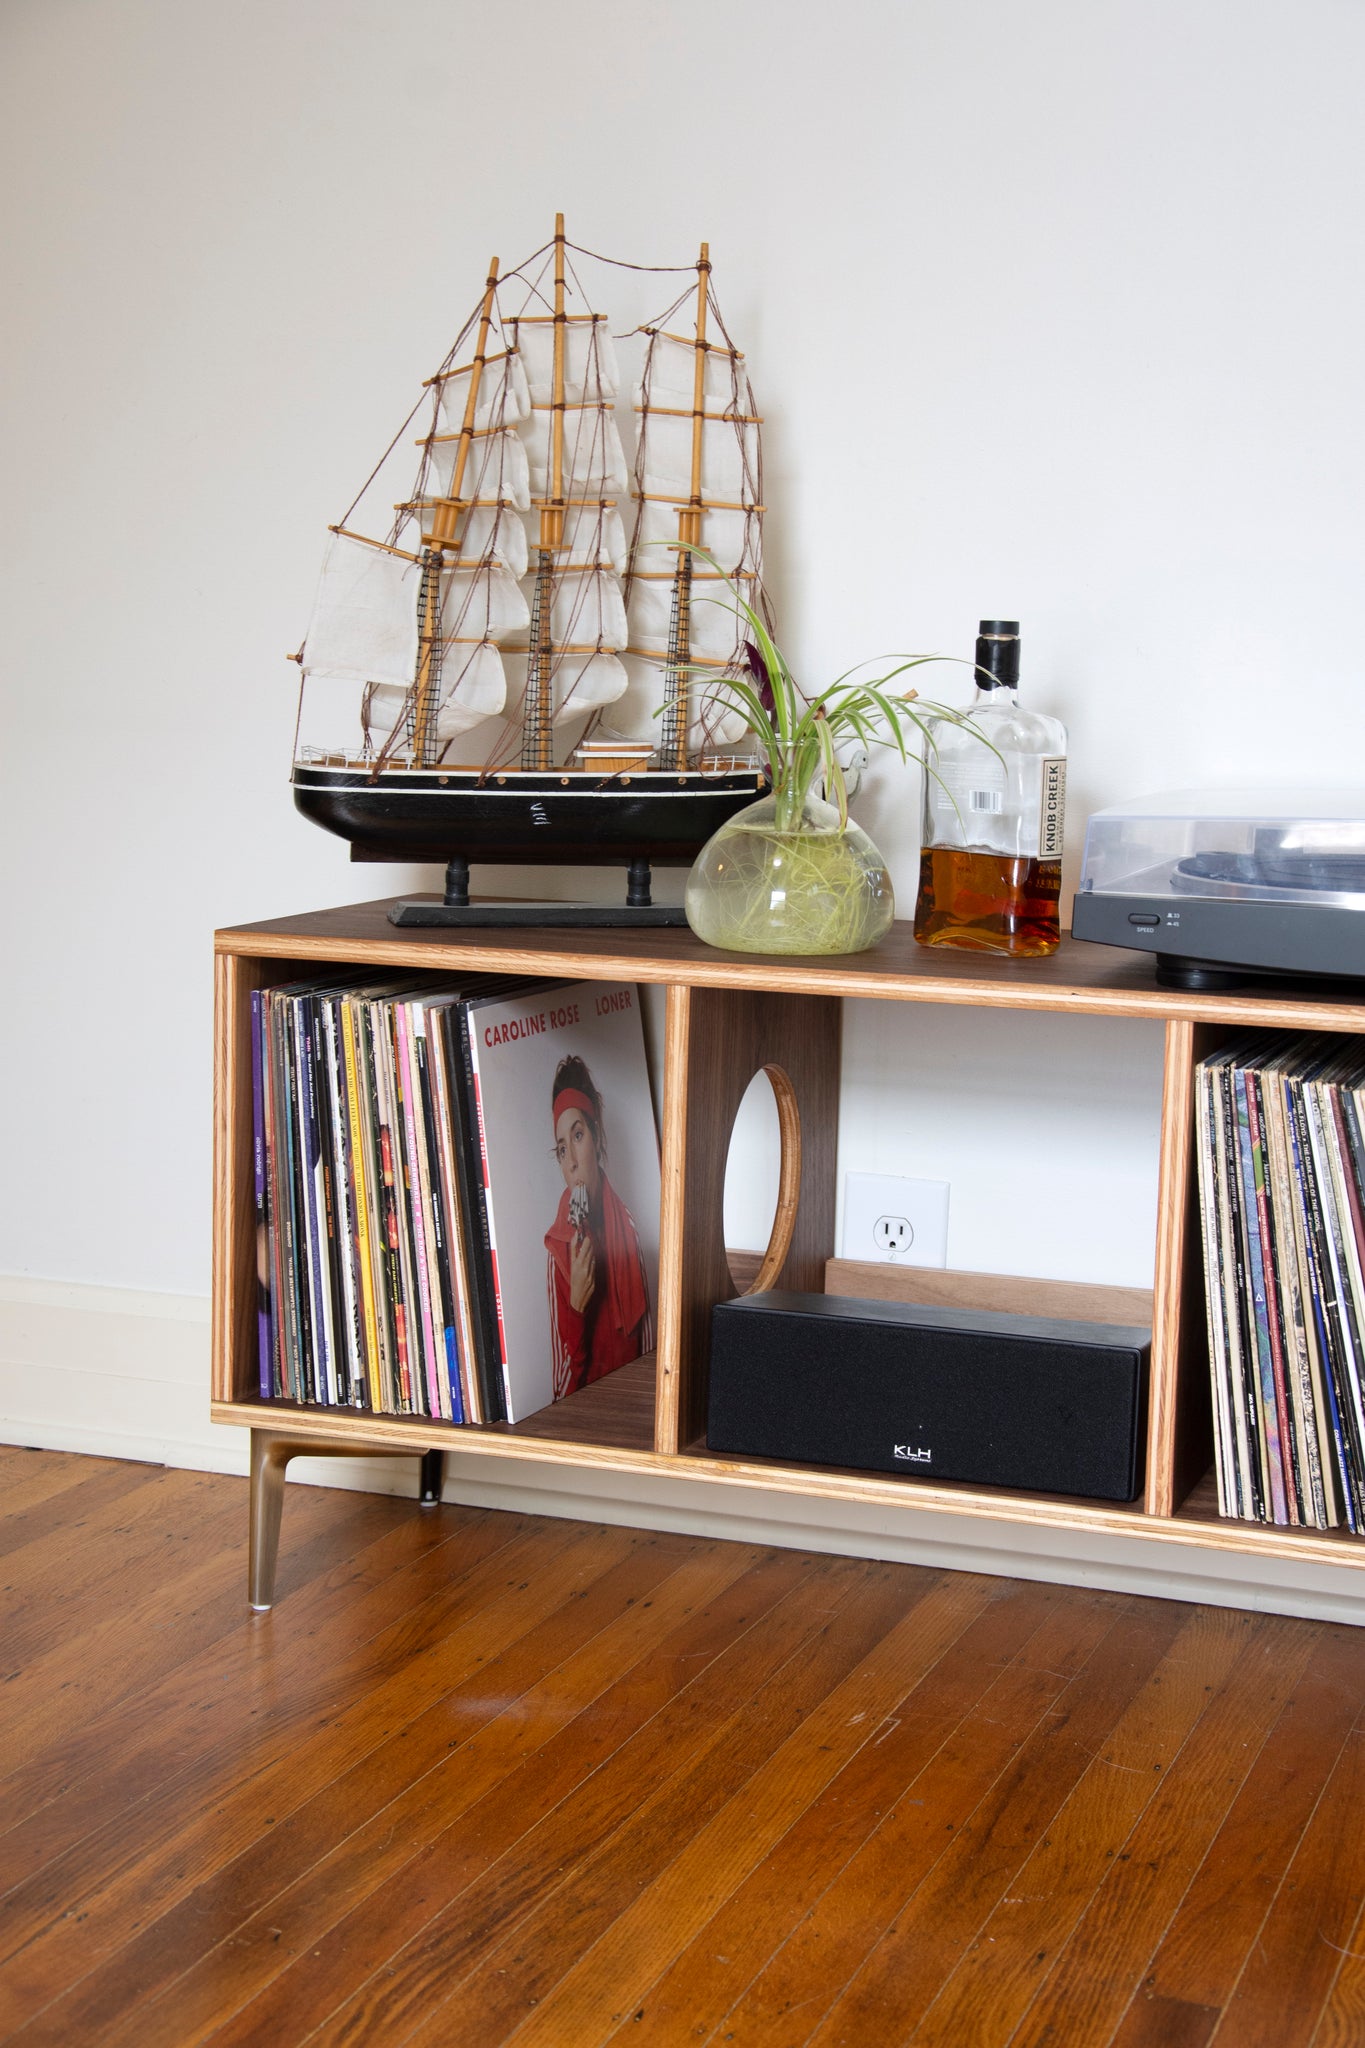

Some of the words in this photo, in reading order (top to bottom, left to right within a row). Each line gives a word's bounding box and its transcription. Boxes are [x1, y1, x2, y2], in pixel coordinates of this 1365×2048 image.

[1047, 766, 1059, 810] CREEK
[1045, 814, 1057, 852] KNOB
[484, 1012, 546, 1048] CAROLINE
[550, 1004, 580, 1029] ROSE
[595, 990, 632, 1016] LONER
[460, 1016, 468, 1048] ANGEL
[464, 1054, 472, 1086] OLSEN
[481, 1206, 489, 1249] MIRRORS
[476, 1102, 484, 1138] CAROLINE
[355, 1172, 361, 1180] TO
[1298, 1116, 1307, 1136] FLOYD
[1310, 1189, 1316, 1197] OF
[356, 1181, 364, 1219] THELONIOUS
[411, 1162, 420, 1204] CANNIBALS
[893, 1444, 932, 1459] KLH
